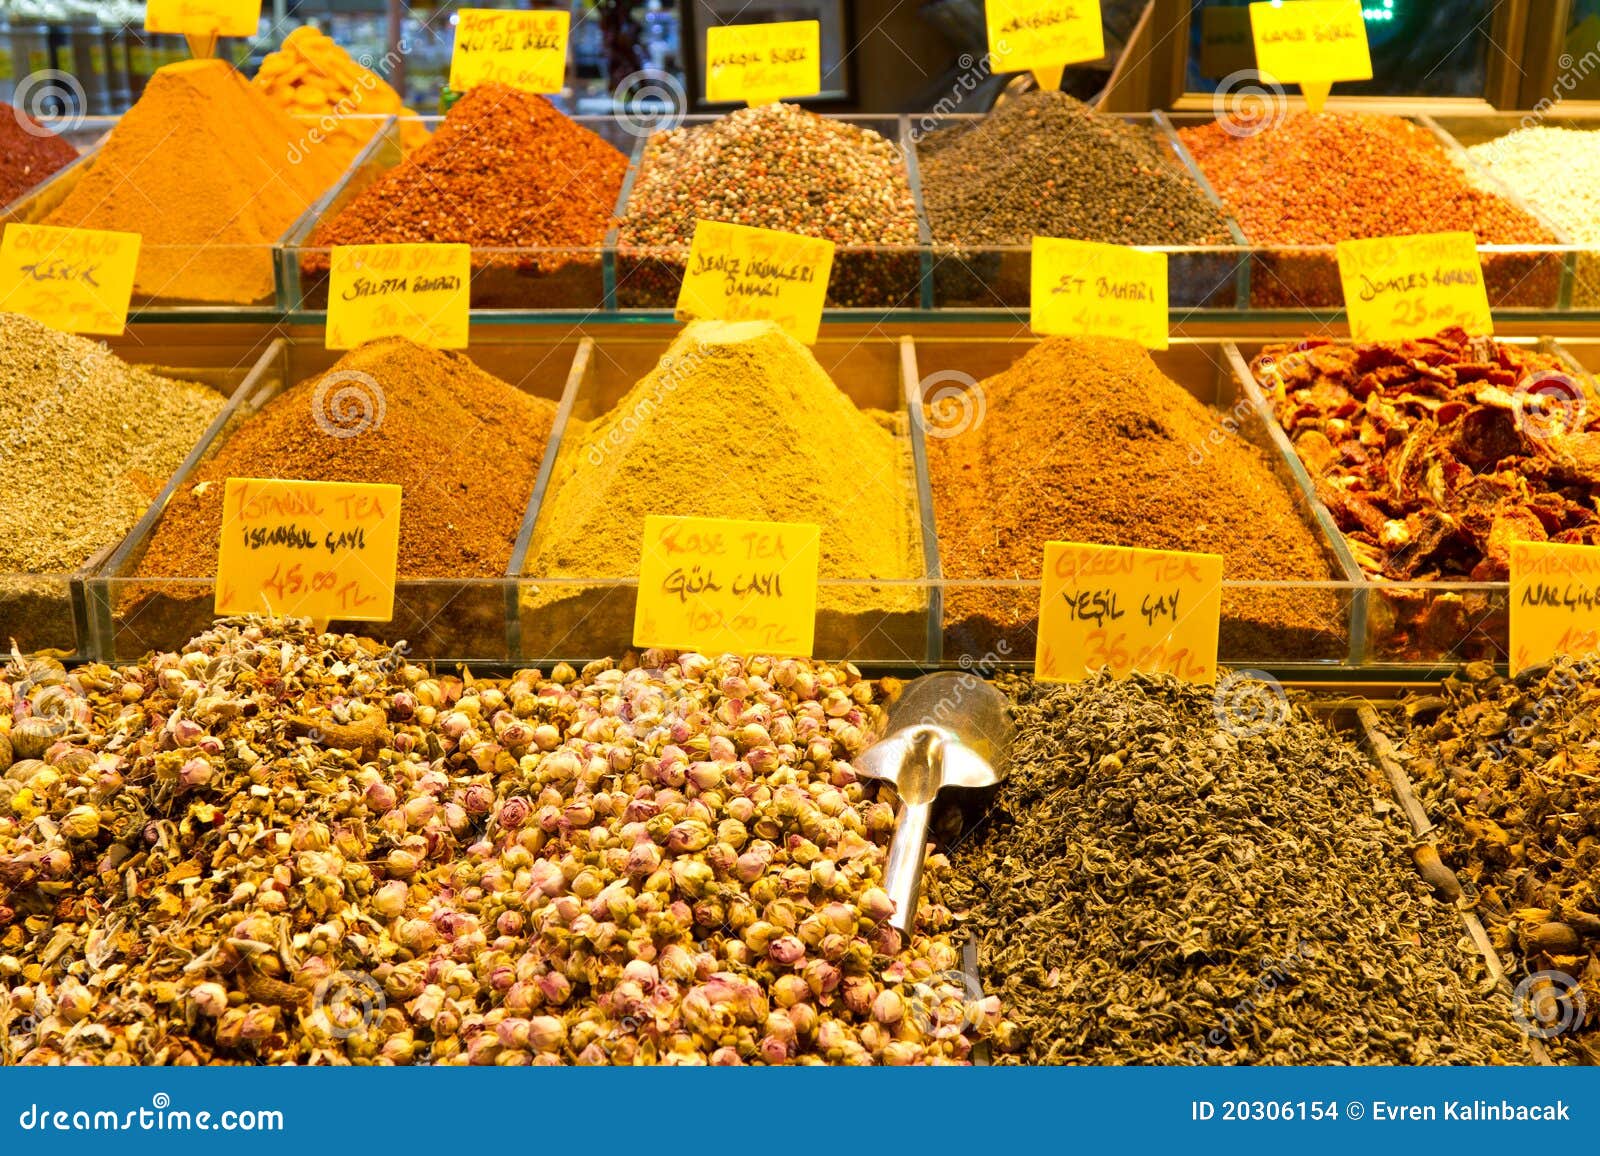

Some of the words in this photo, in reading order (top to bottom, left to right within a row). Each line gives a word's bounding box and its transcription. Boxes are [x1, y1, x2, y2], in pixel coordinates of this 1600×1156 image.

[13, 229, 120, 256] OREGANO
[1051, 275, 1086, 295] ET
[336, 493, 386, 520] TEA
[658, 522, 727, 556] ROSE
[741, 531, 787, 560] TEA
[662, 564, 722, 603] GÜL
[1055, 549, 1135, 584] GREEN
[1143, 554, 1202, 583] TEA
[1062, 588, 1125, 628] YEŞİL
[1140, 588, 1180, 627] ÇAY
